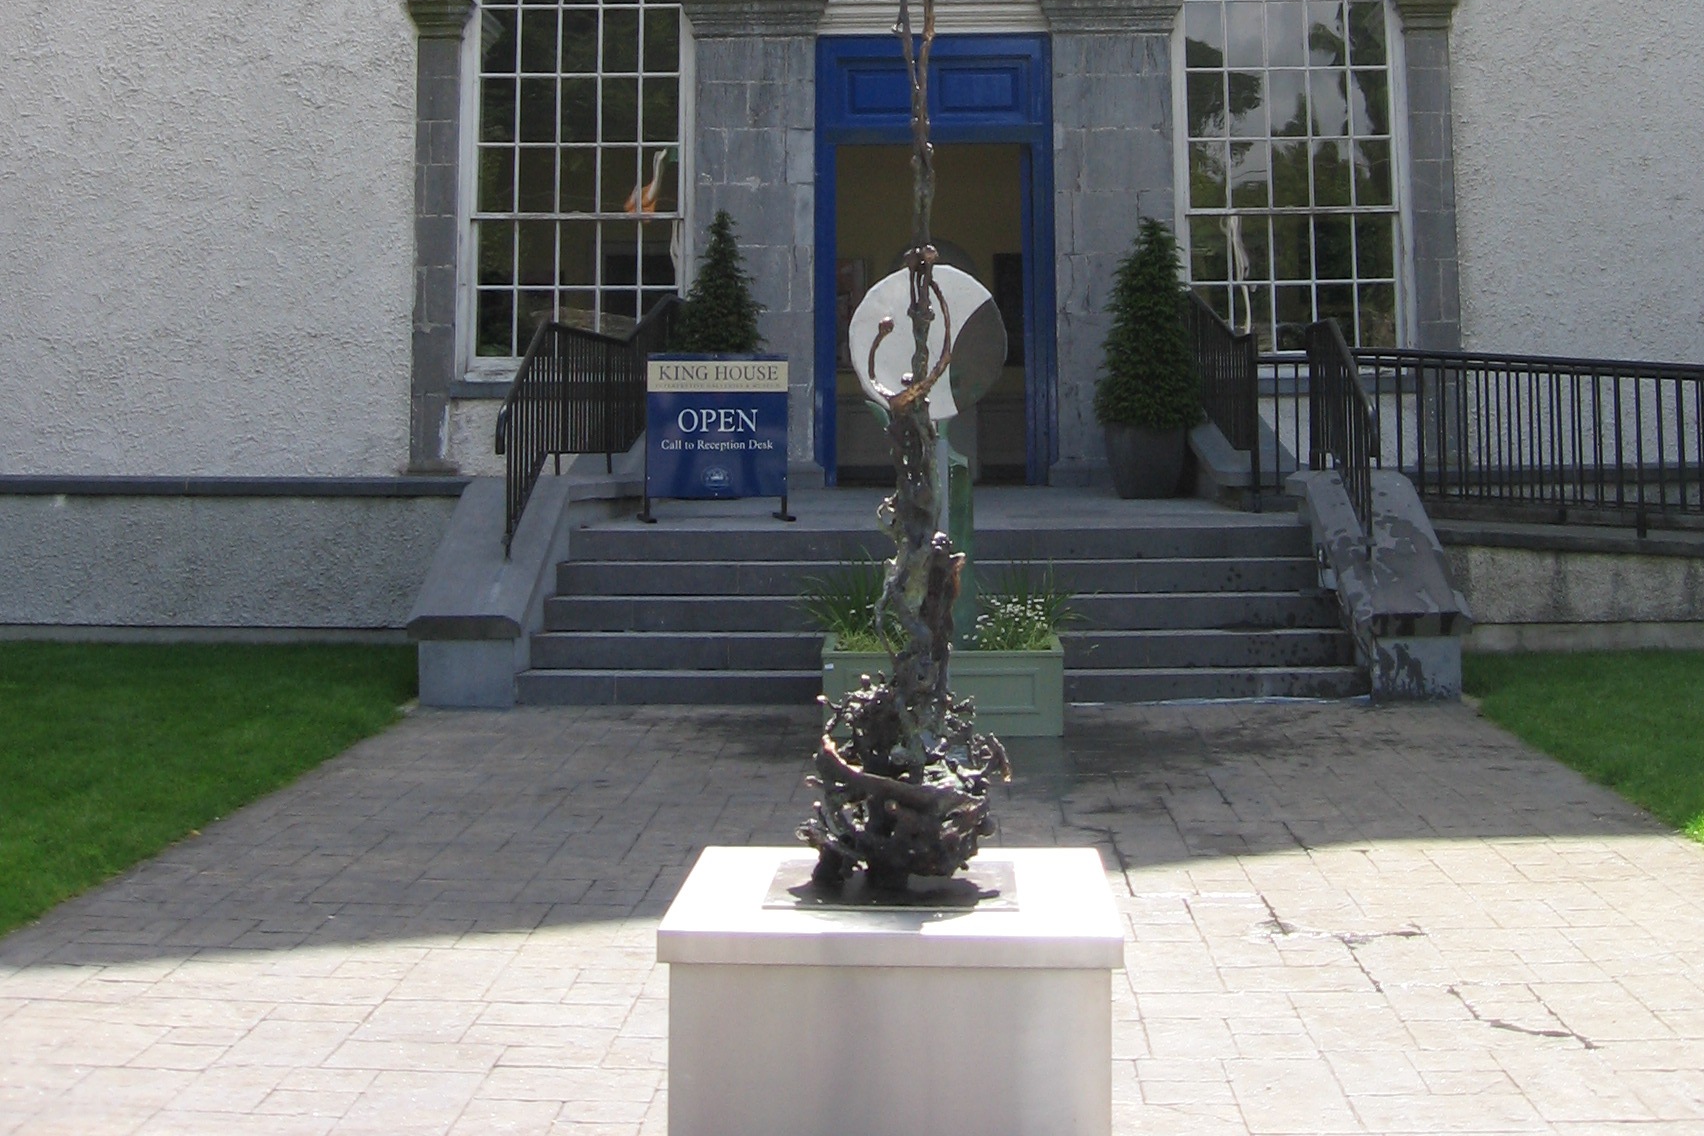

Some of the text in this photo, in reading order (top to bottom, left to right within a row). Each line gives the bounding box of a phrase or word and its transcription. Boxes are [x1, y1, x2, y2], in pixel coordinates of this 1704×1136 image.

[658, 365, 778, 381] KING HOUSE
[677, 409, 758, 433] OPEN
[661, 439, 773, 452] Call to Reception Desk
